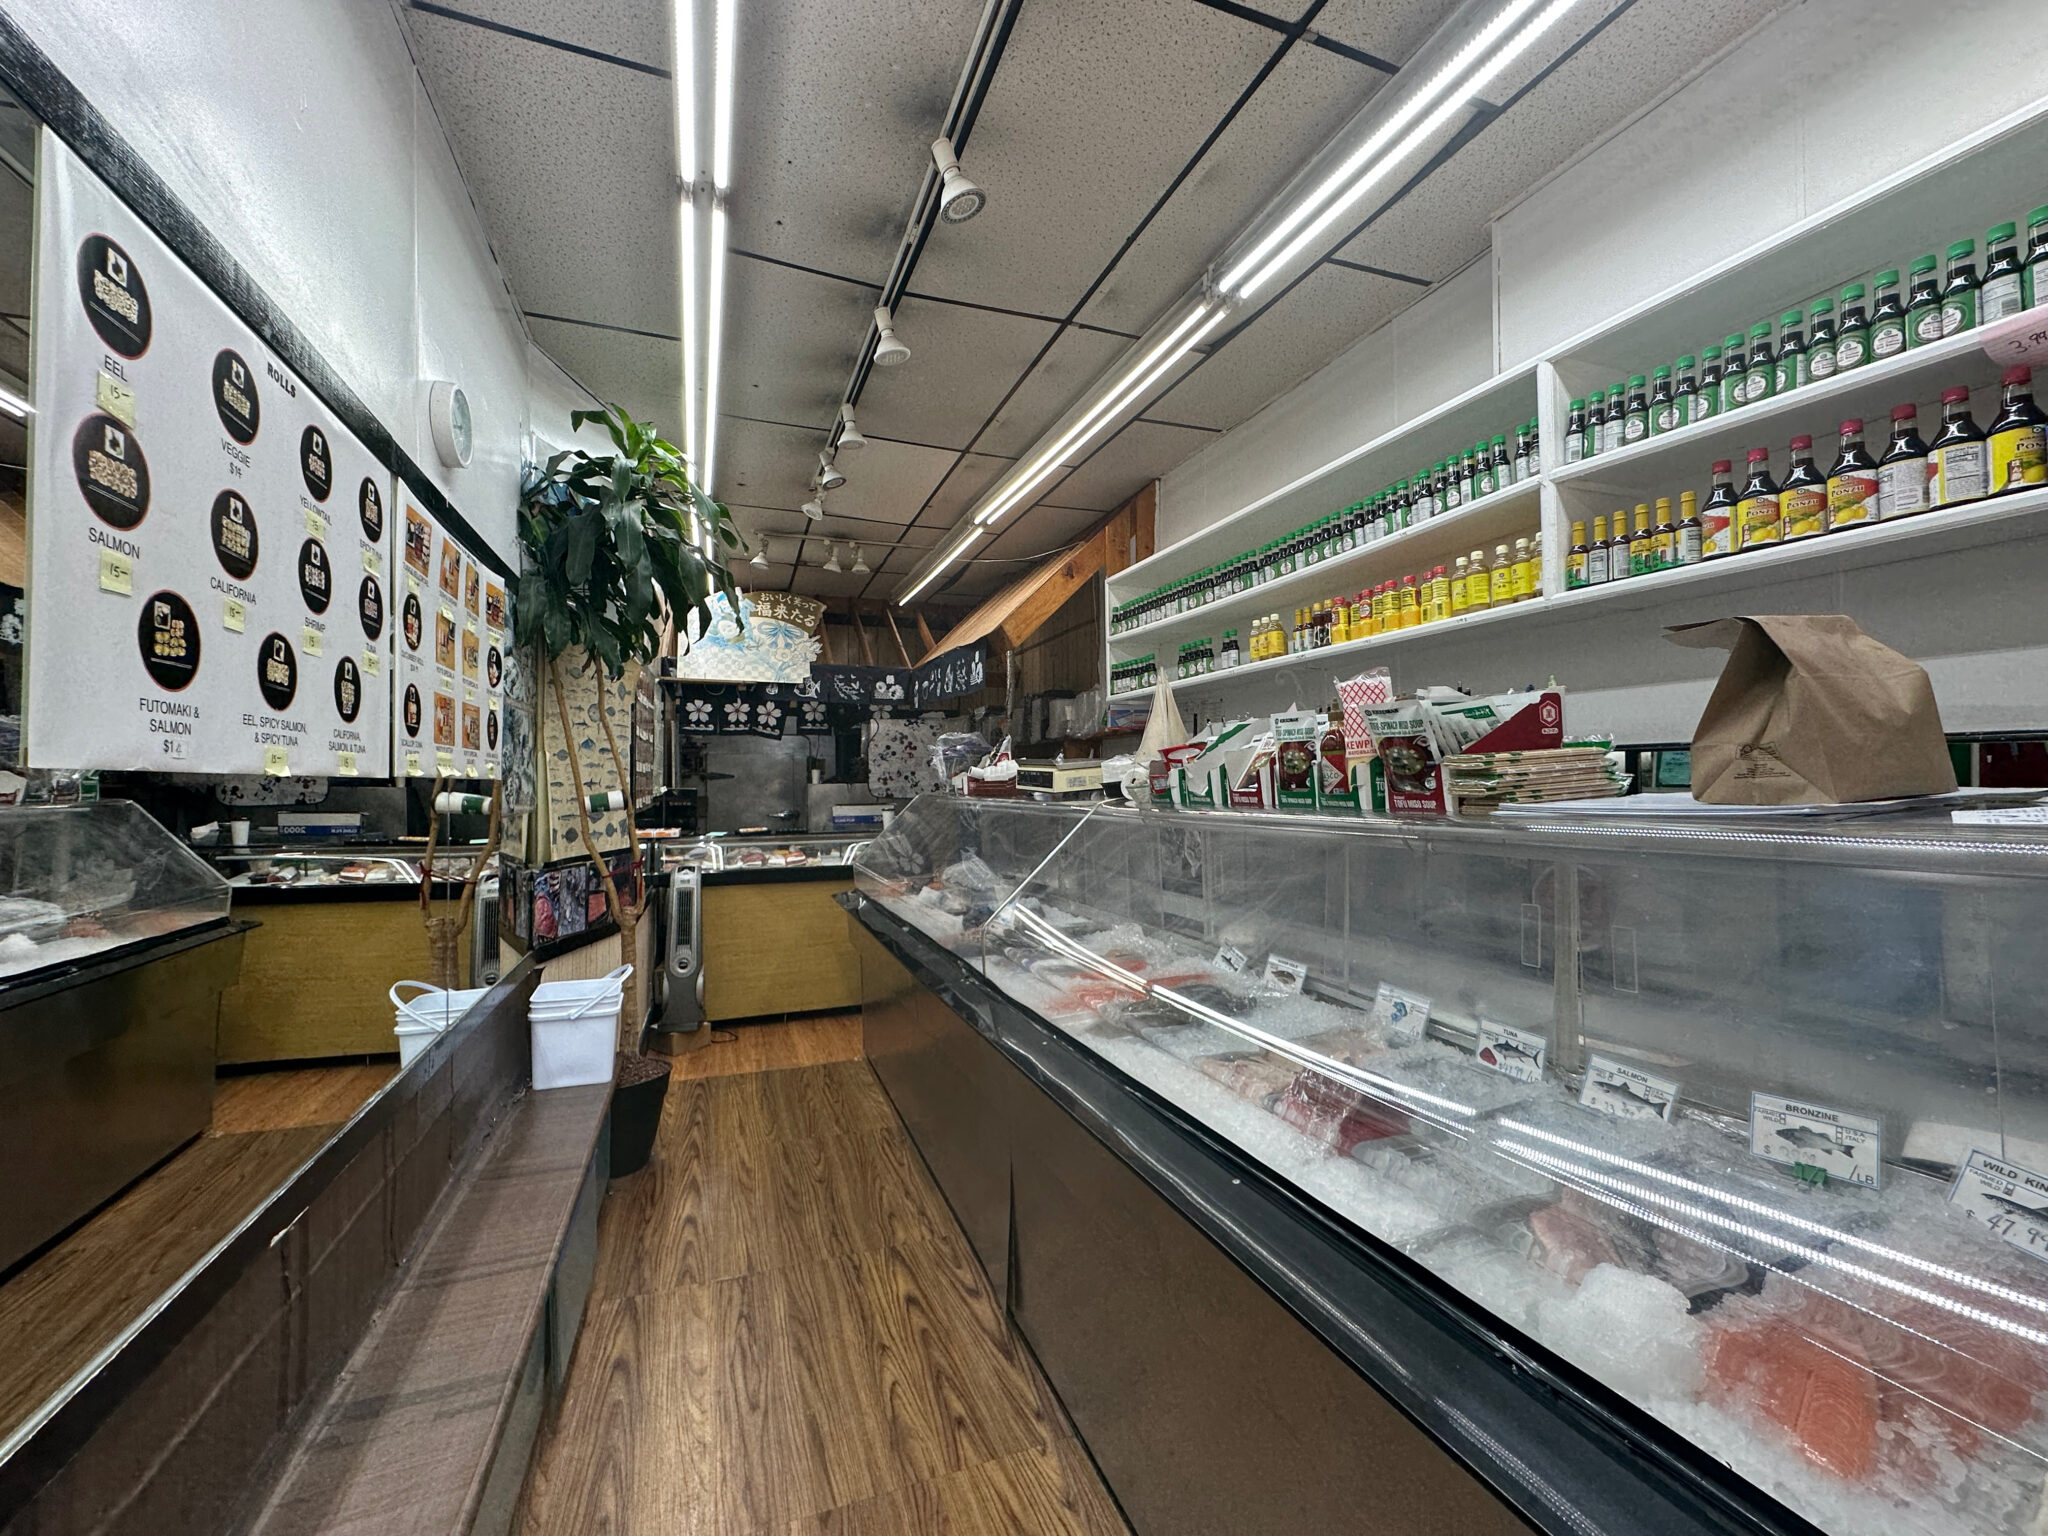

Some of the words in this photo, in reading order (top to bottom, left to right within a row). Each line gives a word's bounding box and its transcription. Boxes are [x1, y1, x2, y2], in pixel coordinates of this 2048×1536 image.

[2008, 330, 2048, 354] 3.99
[104, 354, 128, 382] EEL
[267, 361, 296, 398] ROLLS
[221, 438, 251, 468] VEGGIE
[1831, 484, 1864, 498] PONZU
[1786, 498, 1819, 510] PONZU
[1746, 507, 1776, 518] PONZU
[88, 527, 140, 559] SALMON
[210, 576, 257, 605] CALIFORNIA
[755, 600, 816, 627] 福来たる
[304, 616, 326, 633] SHRIMP
[139, 697, 192, 717] FUTOMAKI
[193, 707, 200, 719] &
[149, 719, 192, 735] SALMON
[259, 715, 280, 730] SPICY
[280, 718, 307, 735] SALMON,
[1409, 719, 1424, 729] SOUP
[254, 732, 260, 743] &
[261, 733, 281, 746] SPICY
[281, 734, 299, 747] TUNA
[328, 740, 348, 753] SALMON
[354, 742, 366, 754] TUNA
[1346, 739, 1375, 750] KEWPI
[1394, 799, 1408, 808] TOFU
[1408, 799, 1422, 808] MISO
[1423, 800, 1437, 809] SOUP
[1503, 1028, 1518, 1038] TUNA
[1616, 1067, 1648, 1084] SALMON
[1762, 1115, 1780, 1123] WILD
[1785, 1103, 1839, 1122] BRONZINE
[1844, 1134, 1866, 1144] ITALY
[1763, 1144, 1772, 1155] $
[1969, 1168, 2003, 1186] FARMED
[1983, 1159, 2018, 1179] WILD
[2025, 1177, 2048, 1193] KIN
[1980, 1179, 2001, 1192] WILD
